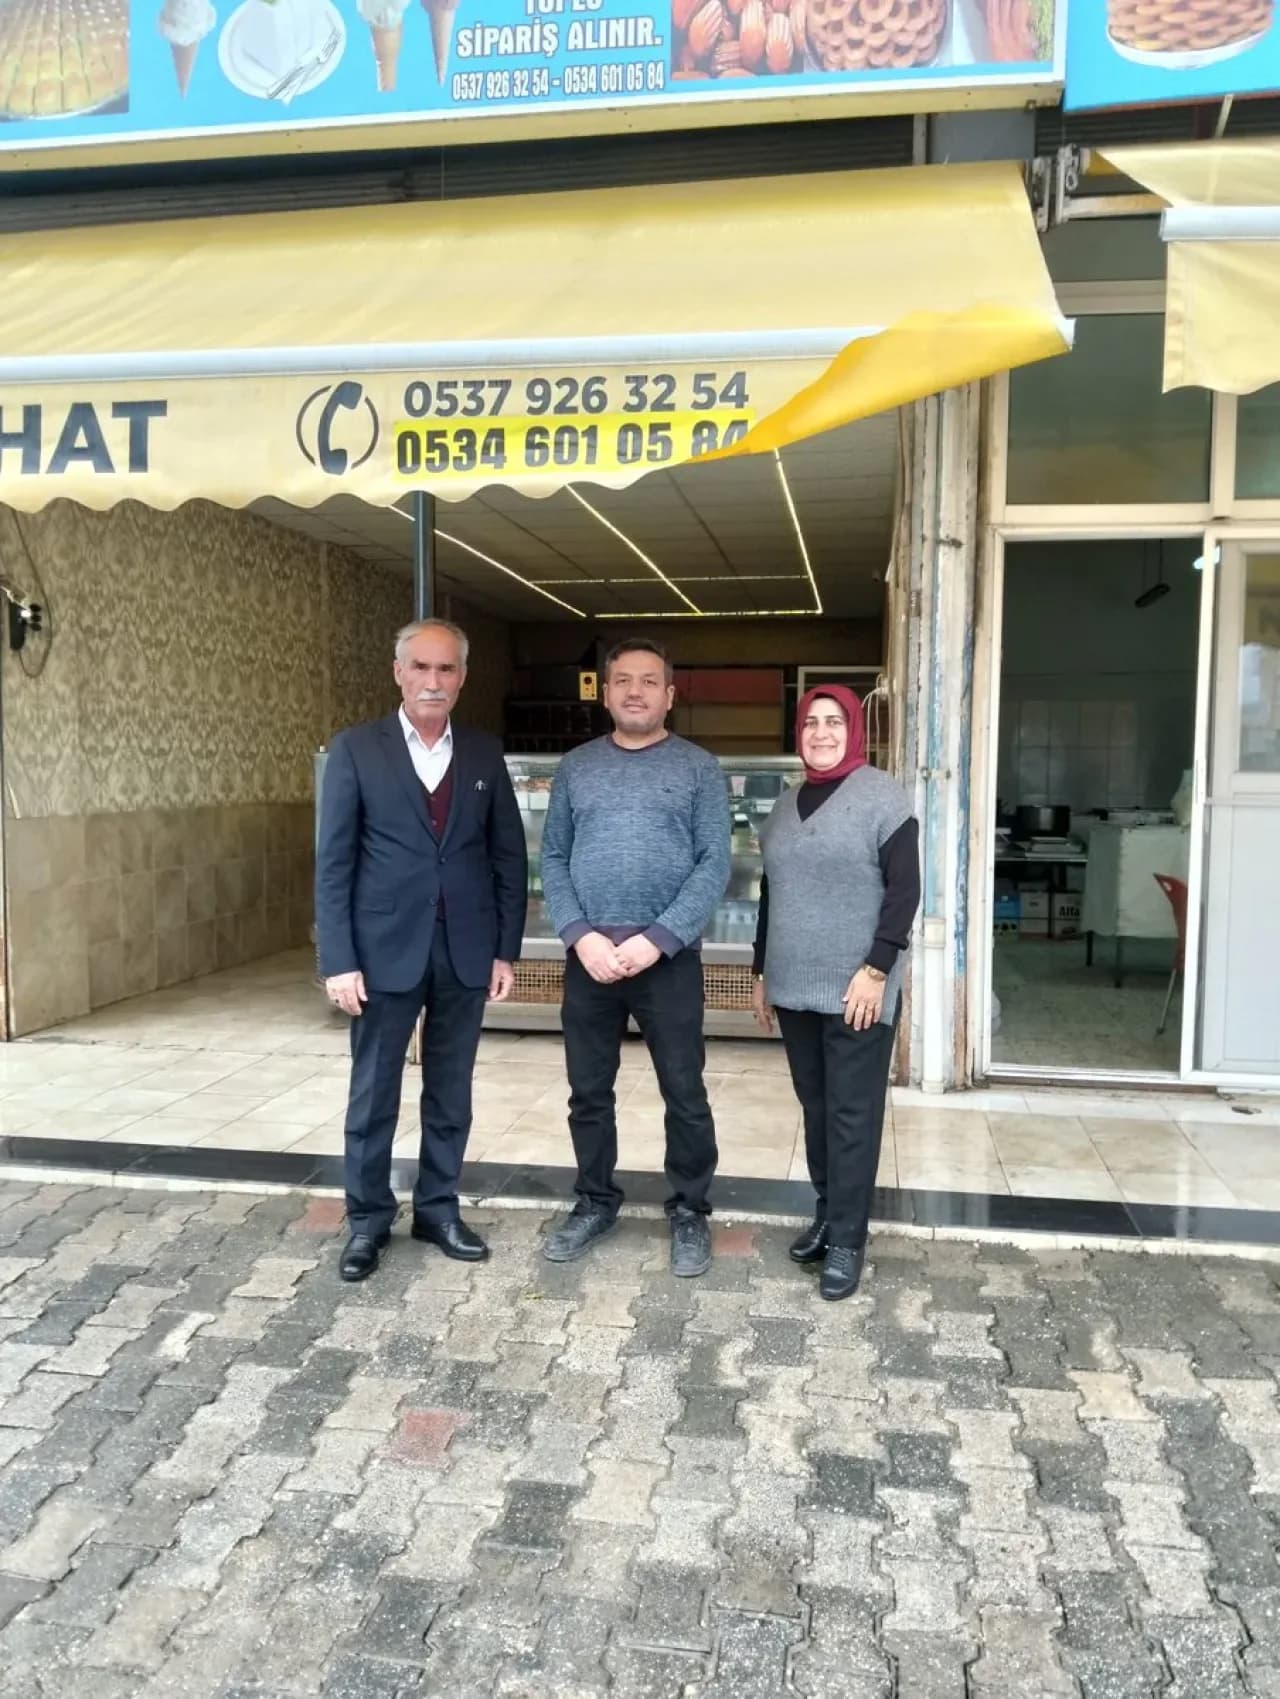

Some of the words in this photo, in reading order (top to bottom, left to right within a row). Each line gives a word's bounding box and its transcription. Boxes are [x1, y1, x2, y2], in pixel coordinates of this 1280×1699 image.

[456, 17, 559, 58] SİPARİŞ
[567, 16, 663, 51] ALINIR.
[452, 71, 484, 101] 0537
[486, 69, 510, 99] 926
[513, 68, 529, 97] 32
[532, 66, 549, 96] 54
[563, 65, 597, 95] 0534
[600, 64, 623, 93] 601
[626, 62, 644, 91] 05
[647, 61, 665, 91] 84
[403, 379, 512, 418] 0537
[525, 376, 608, 416] 926
[622, 374, 677, 413] 32
[691, 371, 749, 410] 54
[397, 428, 507, 475] 0534
[524, 424, 599, 468] 601
[616, 422, 673, 465] 05
